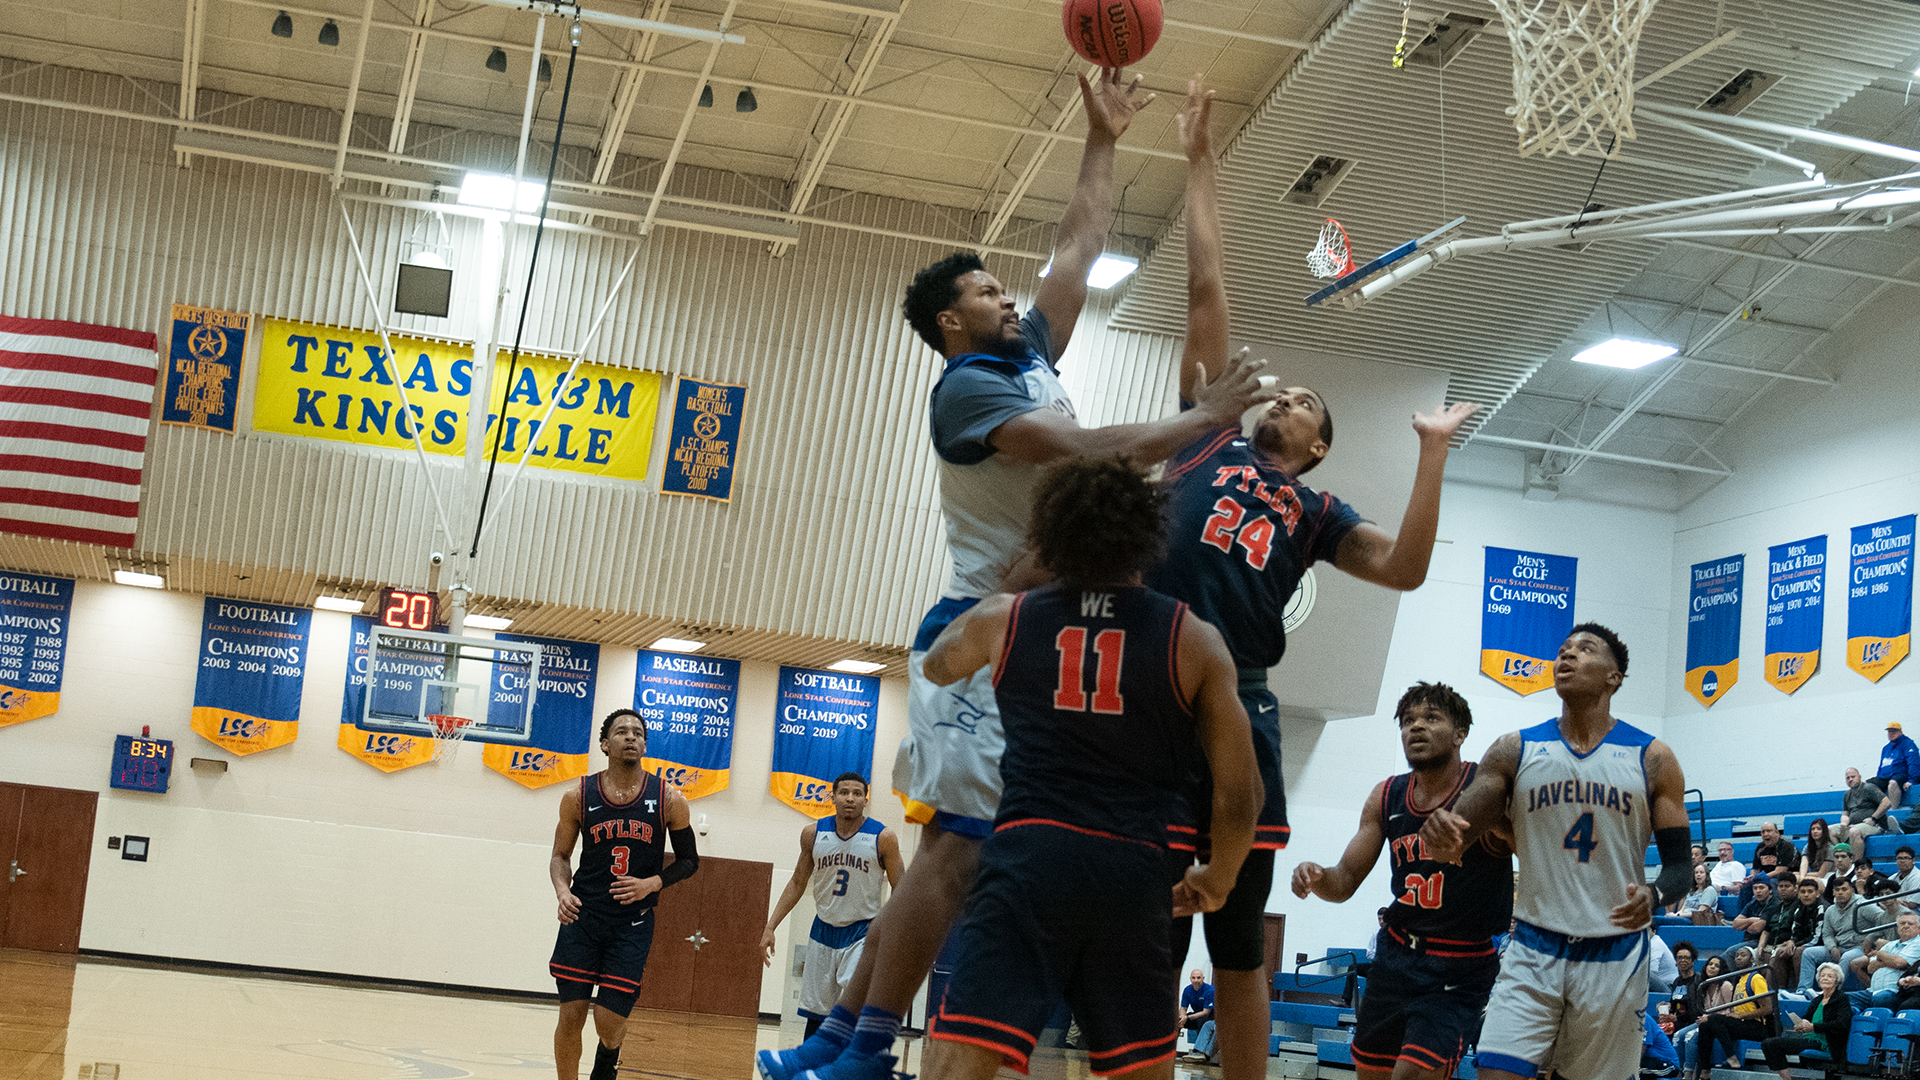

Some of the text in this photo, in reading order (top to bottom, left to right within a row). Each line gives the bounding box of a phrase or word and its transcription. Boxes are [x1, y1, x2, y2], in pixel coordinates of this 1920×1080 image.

[1107, 1, 1131, 64] Wilson
[175, 359, 196, 374] NCAA
[286, 333, 635, 420] TEXAS A&M
[178, 384, 199, 402] ELITE
[697, 385, 728, 402] WOMEN'S
[687, 396, 732, 417] BASKETBALL
[700, 439, 730, 455] CHAMPS
[674, 448, 730, 469] NCAA REGIONAL
[681, 463, 720, 480] PLAYOFFS
[687, 477, 708, 491] 2000
[1212, 466, 1304, 536] TYLER
[1200, 495, 1275, 572] 24
[1871, 525, 1893, 540] MEN'S
[1787, 544, 1807, 558] MEN'S
[1852, 533, 1912, 557] CROSS COUNTRY
[1517, 554, 1546, 569] MEN'S
[1694, 568, 1715, 582] TRACK
[1715, 564, 1722, 577] &
[1722, 561, 1742, 576] FIELD
[1771, 553, 1825, 574] TRACK & FIELD
[1854, 557, 1908, 585] CHAMPIONS
[1489, 576, 1570, 592] LONE STAR CONFERENCE
[1512, 566, 1549, 581] GOLF
[1489, 584, 1568, 610] CHAMPIONS
[1771, 575, 1822, 601] CHAMPIONS
[1851, 582, 1889, 598] 1984 1986
[386, 591, 431, 630] 20
[1081, 591, 1117, 618] WE
[1487, 603, 1512, 615] 1969
[1693, 588, 1738, 613] CHAMPIONS
[1787, 598, 1803, 611] 1970
[1804, 595, 1822, 607] 2014
[218, 603, 298, 626] FOOTBALL
[1768, 615, 1784, 627] 2016
[208, 622, 303, 641] LONE STAR CONFERENCE
[34, 636, 62, 649] 1988
[207, 637, 300, 665] CHAMPIONS
[1863, 641, 1883, 662] LSC
[0, 656, 60, 673] 995 1996
[33, 648, 60, 661] 1993
[354, 646, 373, 655] LON
[398, 652, 444, 664] CONFERENC
[0, 668, 57, 685] 001 2002
[202, 656, 301, 678] 2003 2004 2009
[354, 655, 445, 681] CHAMPIONS
[499, 664, 519, 673] LONE
[542, 668, 590, 681] CONFERENCE
[652, 656, 724, 677] BASEBALL
[1053, 625, 1126, 716] 11
[1502, 658, 1533, 679] LSC
[1777, 657, 1798, 678] LSC
[384, 679, 413, 692] 1996
[499, 673, 588, 699] CHAMPIONS
[642, 674, 732, 691] LONE STAR CONFERENCE
[793, 672, 864, 693] SOFTBALL
[1702, 682, 1718, 691] NCAA
[494, 692, 523, 704] 2000
[642, 688, 729, 714] CHAMPIONS
[784, 691, 872, 708] LONE STAR CONFERENCE
[219, 717, 254, 738] LSC
[639, 707, 731, 727] 1995 1998 2004
[784, 704, 868, 731] CHAMPIONS
[646, 720, 730, 738] 008 2014 2015
[779, 723, 838, 739] 2002 2019
[130, 740, 167, 759] 8:34
[365, 734, 399, 755] LSC
[510, 751, 544, 772] LSC
[656, 766, 687, 787] LSC
[794, 782, 827, 802] LSC
[1527, 778, 1633, 816] JAVELINAS
[644, 799, 658, 813] T
[590, 819, 653, 844] TYLER
[1562, 810, 1599, 864] 4
[610, 845, 630, 876] 3
[1391, 833, 1434, 868] TYL
[817, 852, 870, 873] JAVELINAS
[831, 868, 850, 897] 3
[1397, 871, 1445, 910] 20
[1408, 934, 1420, 950] T
